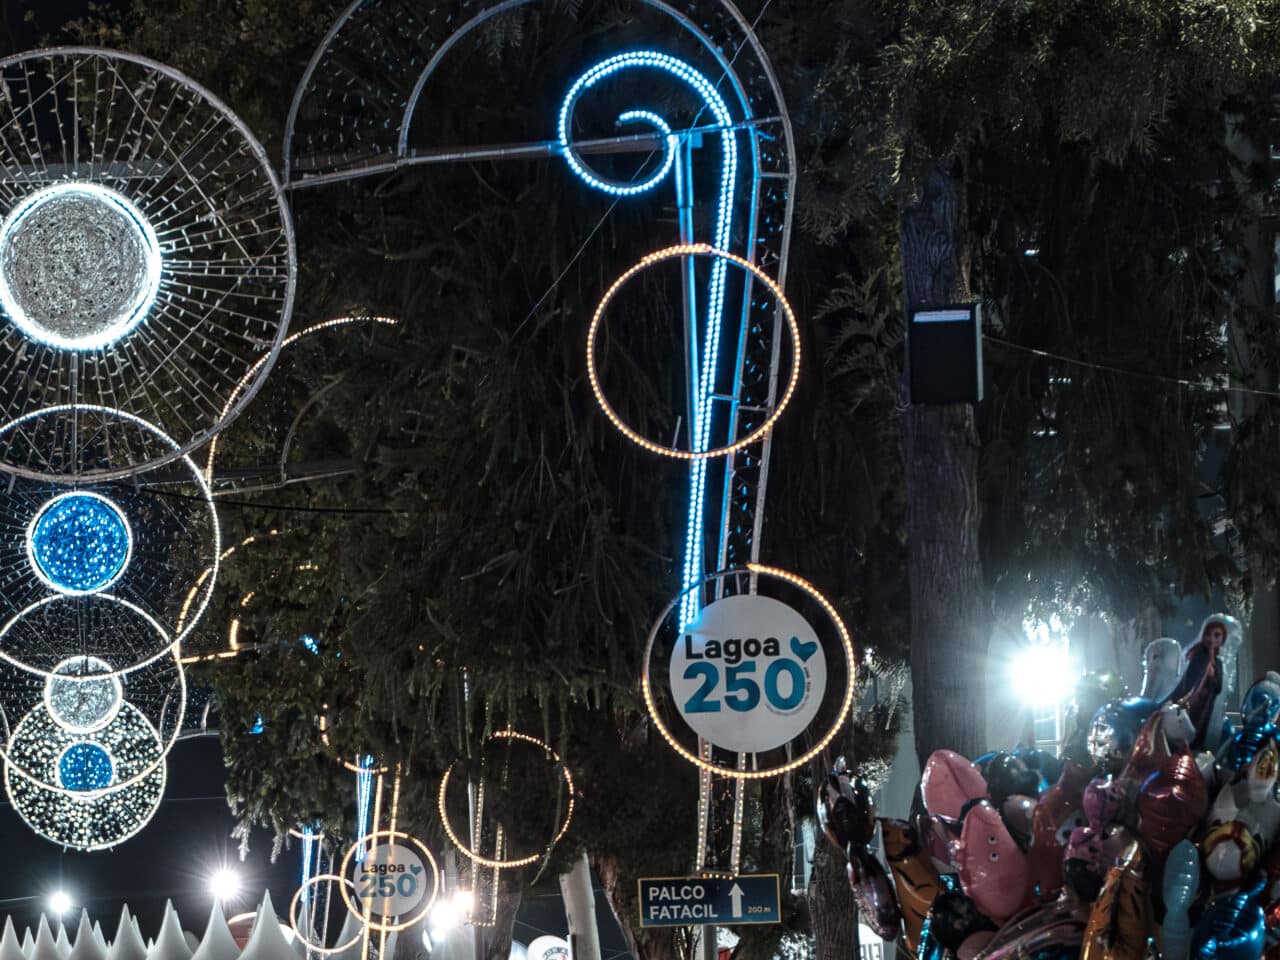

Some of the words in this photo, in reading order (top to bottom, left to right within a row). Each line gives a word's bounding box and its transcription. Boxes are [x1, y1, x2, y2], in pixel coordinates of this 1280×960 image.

[685, 635, 781, 665] Lagoa
[683, 658, 806, 714] 250
[361, 862, 405, 875] Lagoa
[360, 873, 417, 897] 250
[649, 886, 705, 900] PALCO
[650, 904, 718, 919] FATACIL
